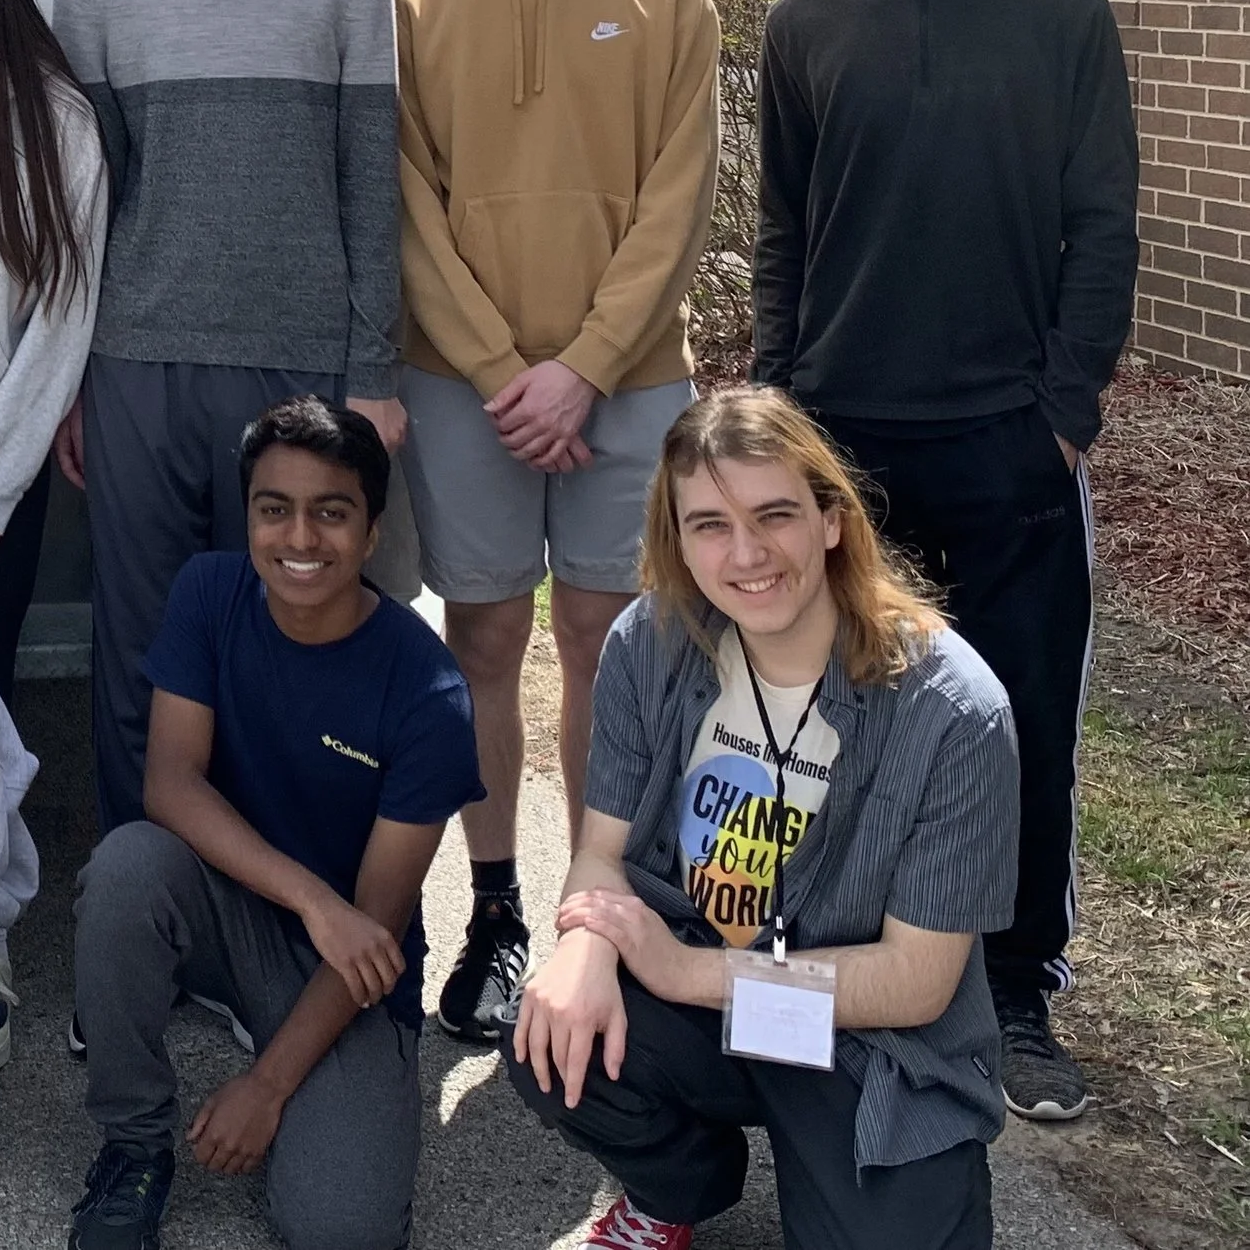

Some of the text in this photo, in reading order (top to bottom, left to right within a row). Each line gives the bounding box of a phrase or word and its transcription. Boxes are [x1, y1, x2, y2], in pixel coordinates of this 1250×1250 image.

[332, 739, 380, 769] Columbia
[712, 721, 762, 759] Houses
[693, 833, 793, 879] you
[688, 864, 772, 927] WORL
